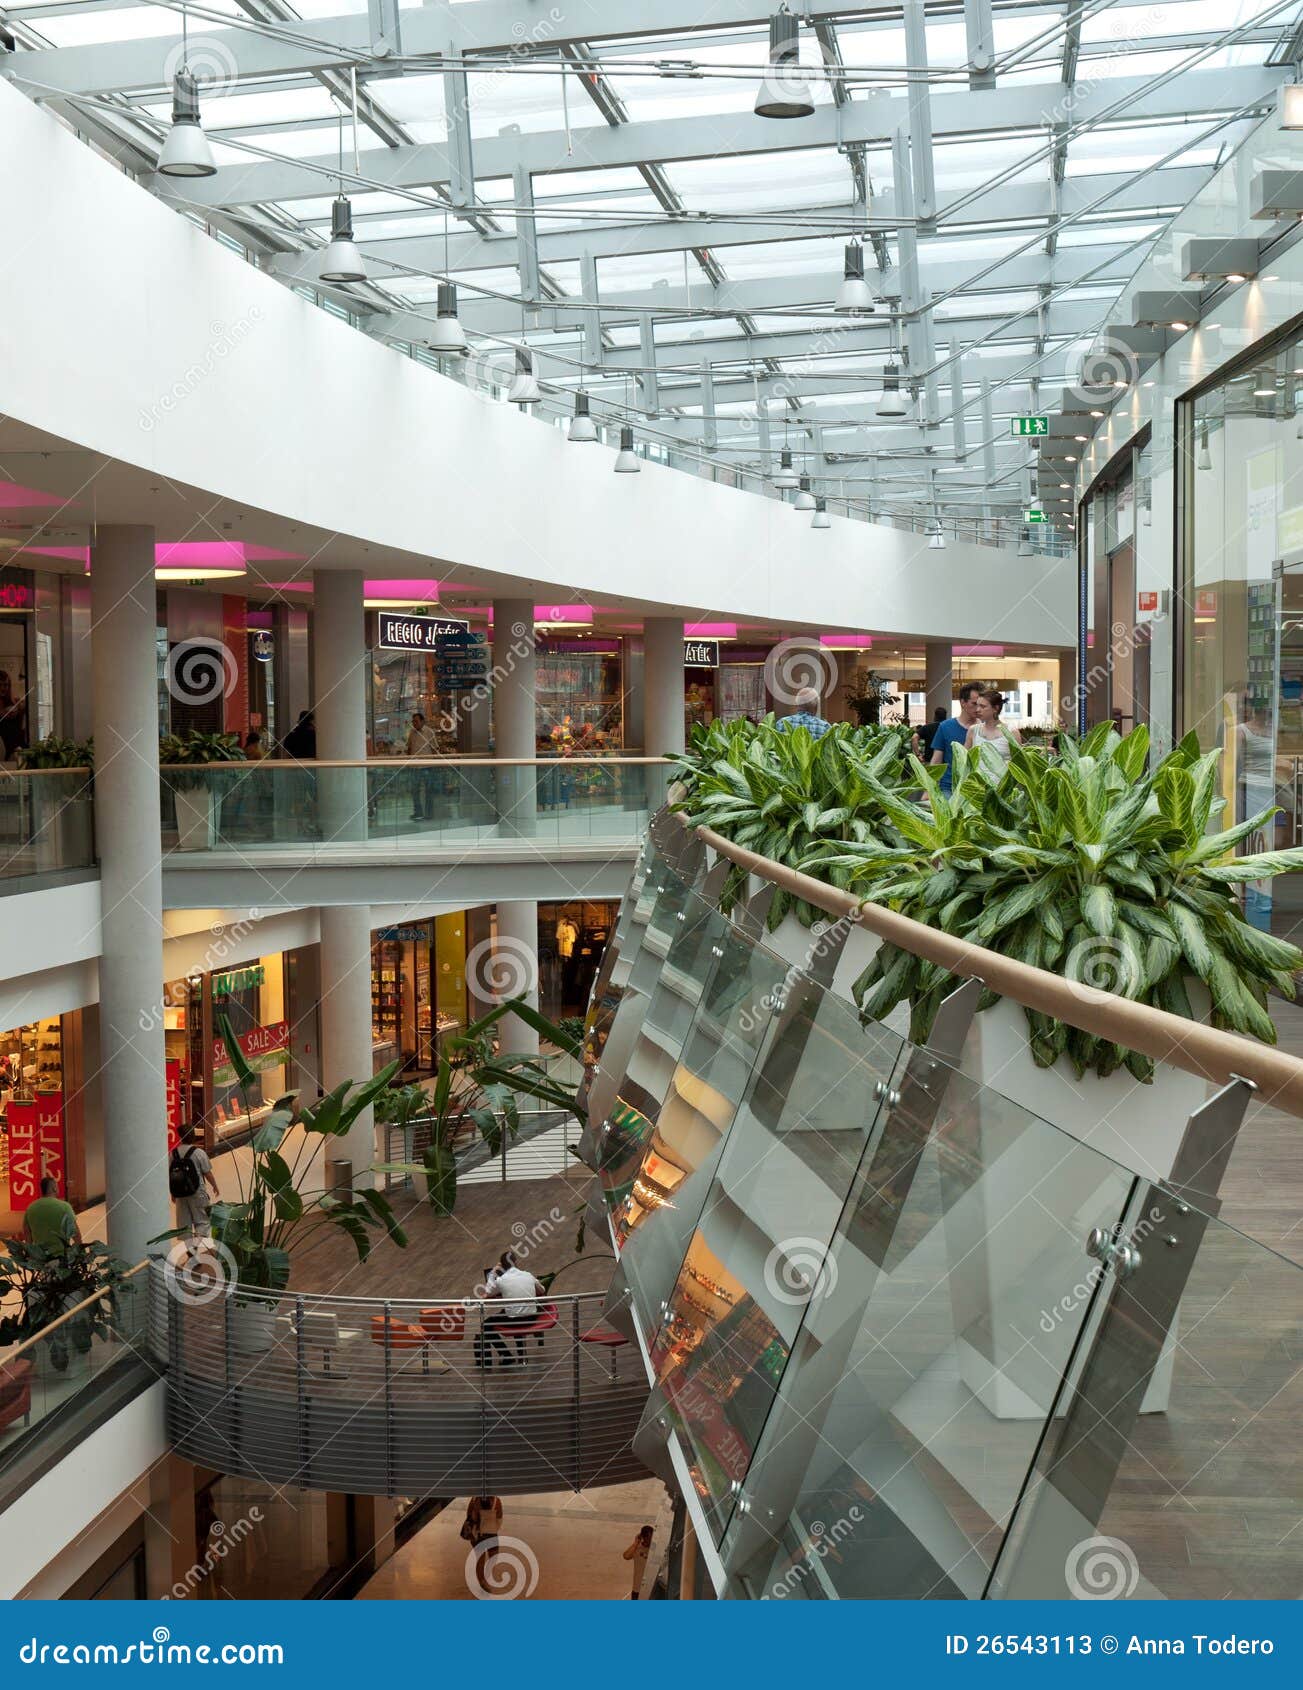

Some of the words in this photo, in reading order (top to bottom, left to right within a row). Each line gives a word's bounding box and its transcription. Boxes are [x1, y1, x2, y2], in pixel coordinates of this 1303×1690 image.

[387, 621, 422, 645] REGIO
[685, 642, 711, 662] ÁTÉK
[214, 1042, 228, 1061] SA
[247, 1030, 270, 1052] SALE
[279, 1024, 290, 1042] SA
[12, 1124, 34, 1196] SALE
